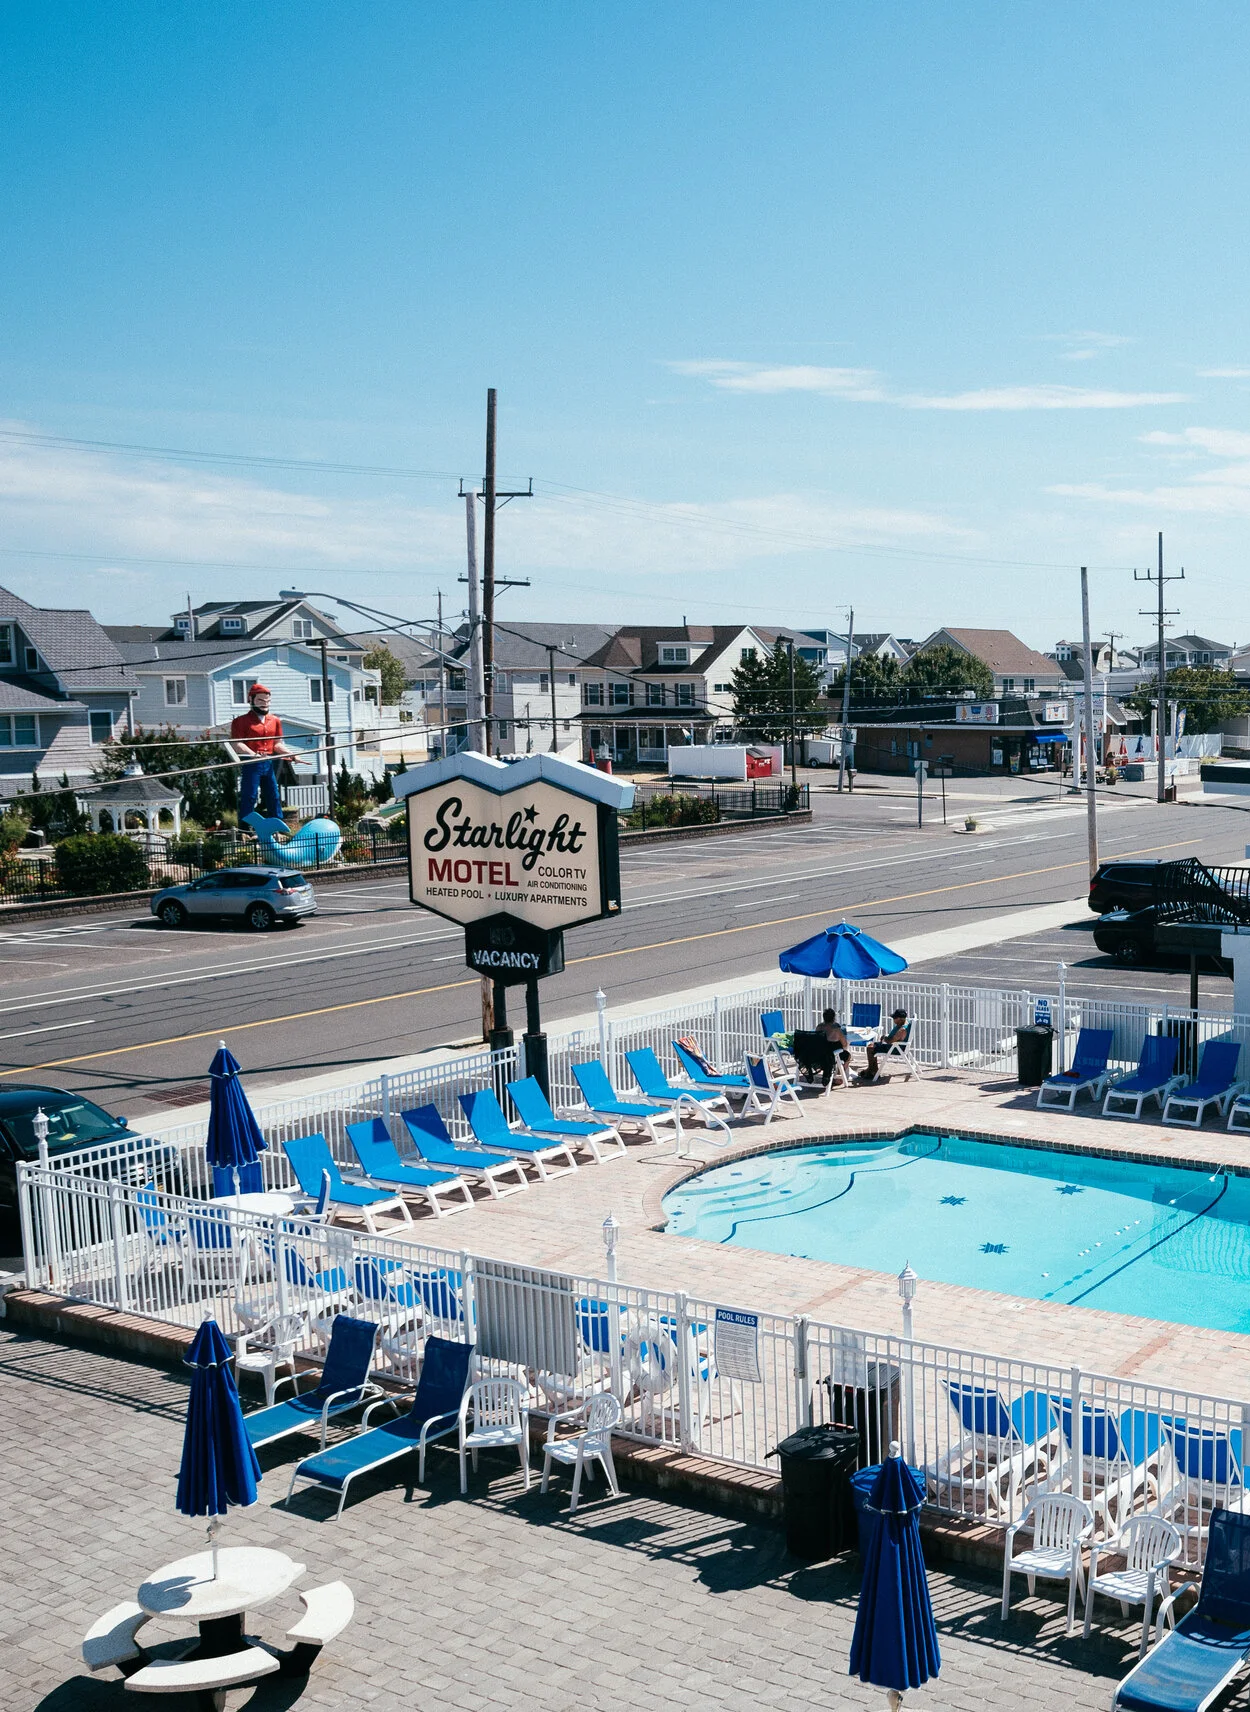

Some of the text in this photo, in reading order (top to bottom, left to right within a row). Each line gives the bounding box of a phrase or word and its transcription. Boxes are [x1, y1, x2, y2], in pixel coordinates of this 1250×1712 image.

[424, 797, 587, 871] Starlight
[428, 858, 519, 886] MOTEL
[538, 866, 587, 879] COLOR TV
[527, 880, 587, 891] AIR CONDITIONING
[426, 887, 587, 906] HEATED POOL LUXURY APARTMENTS
[473, 949, 540, 969] VACANCY
[718, 1311, 756, 1325] POOL RULES
